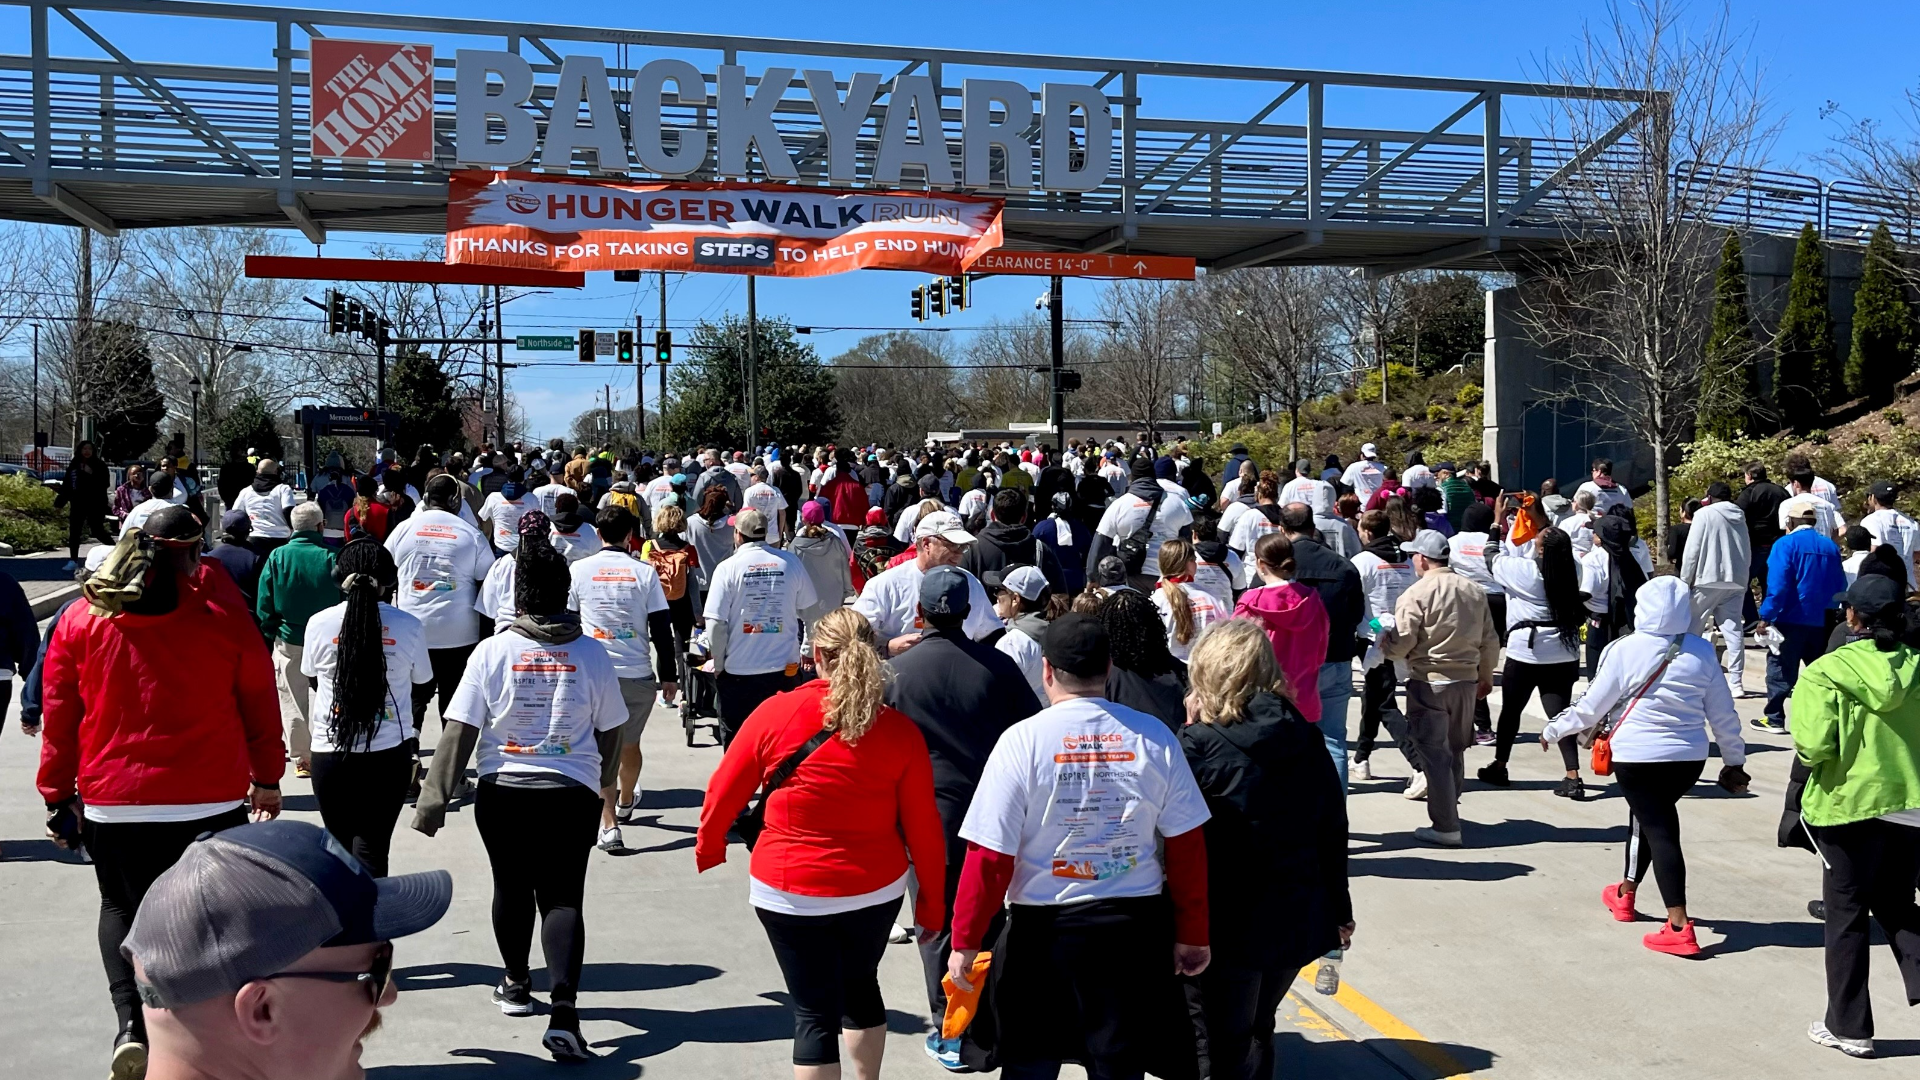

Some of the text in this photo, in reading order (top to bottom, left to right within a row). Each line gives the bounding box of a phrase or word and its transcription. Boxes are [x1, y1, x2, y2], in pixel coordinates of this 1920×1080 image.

[323, 53, 375, 100] THE
[312, 44, 432, 158] HOME
[360, 87, 432, 159] DEPOT
[456, 48, 1112, 193] BACKYARD
[547, 194, 960, 230] HUNGER WALK RUN
[454, 237, 548, 256] THANKS
[555, 243, 600, 259] FOR
[606, 242, 689, 256] TAKING
[700, 242, 770, 260] STEPS
[778, 247, 807, 262] TO
[813, 241, 868, 262] HELP
[875, 239, 918, 252] END
[971, 255, 1052, 270] LEARANCE
[527, 338, 563, 348] Northside
[1078, 734, 1123, 743] HUNGER
[1093, 770, 1139, 778] NORTHSIDE
